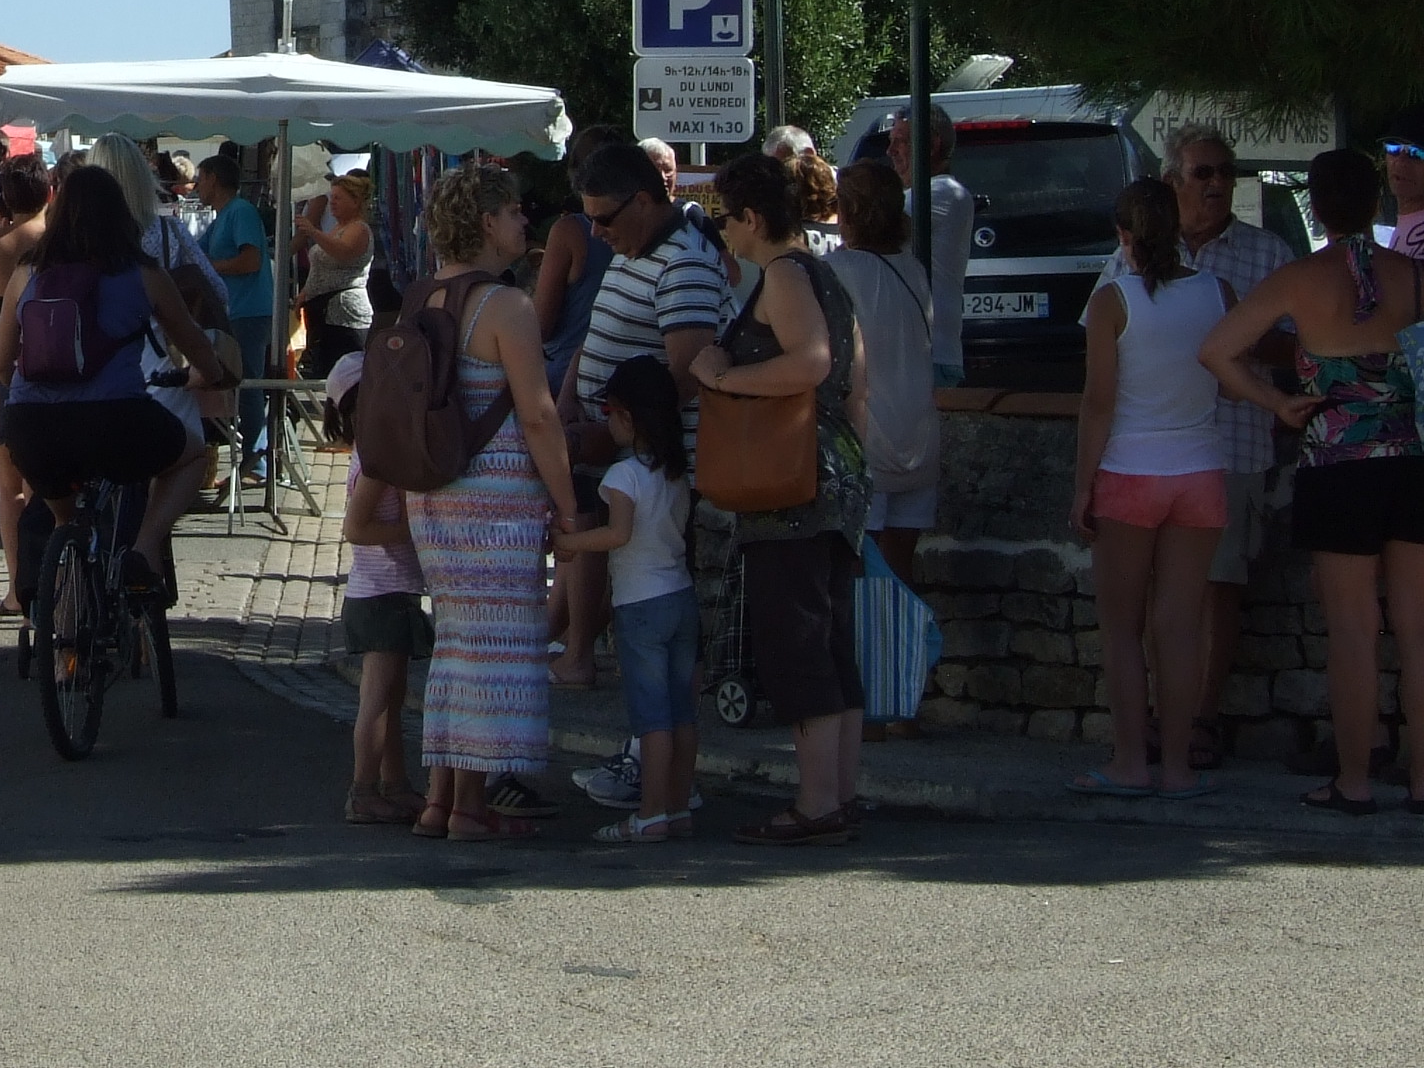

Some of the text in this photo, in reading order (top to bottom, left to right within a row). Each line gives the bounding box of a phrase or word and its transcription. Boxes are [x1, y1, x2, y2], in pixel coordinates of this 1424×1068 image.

[680, 81, 734, 92] DU LUNDI
[668, 97, 746, 108] AU VENDREDI
[669, 121, 744, 134] MAXI 1h30
